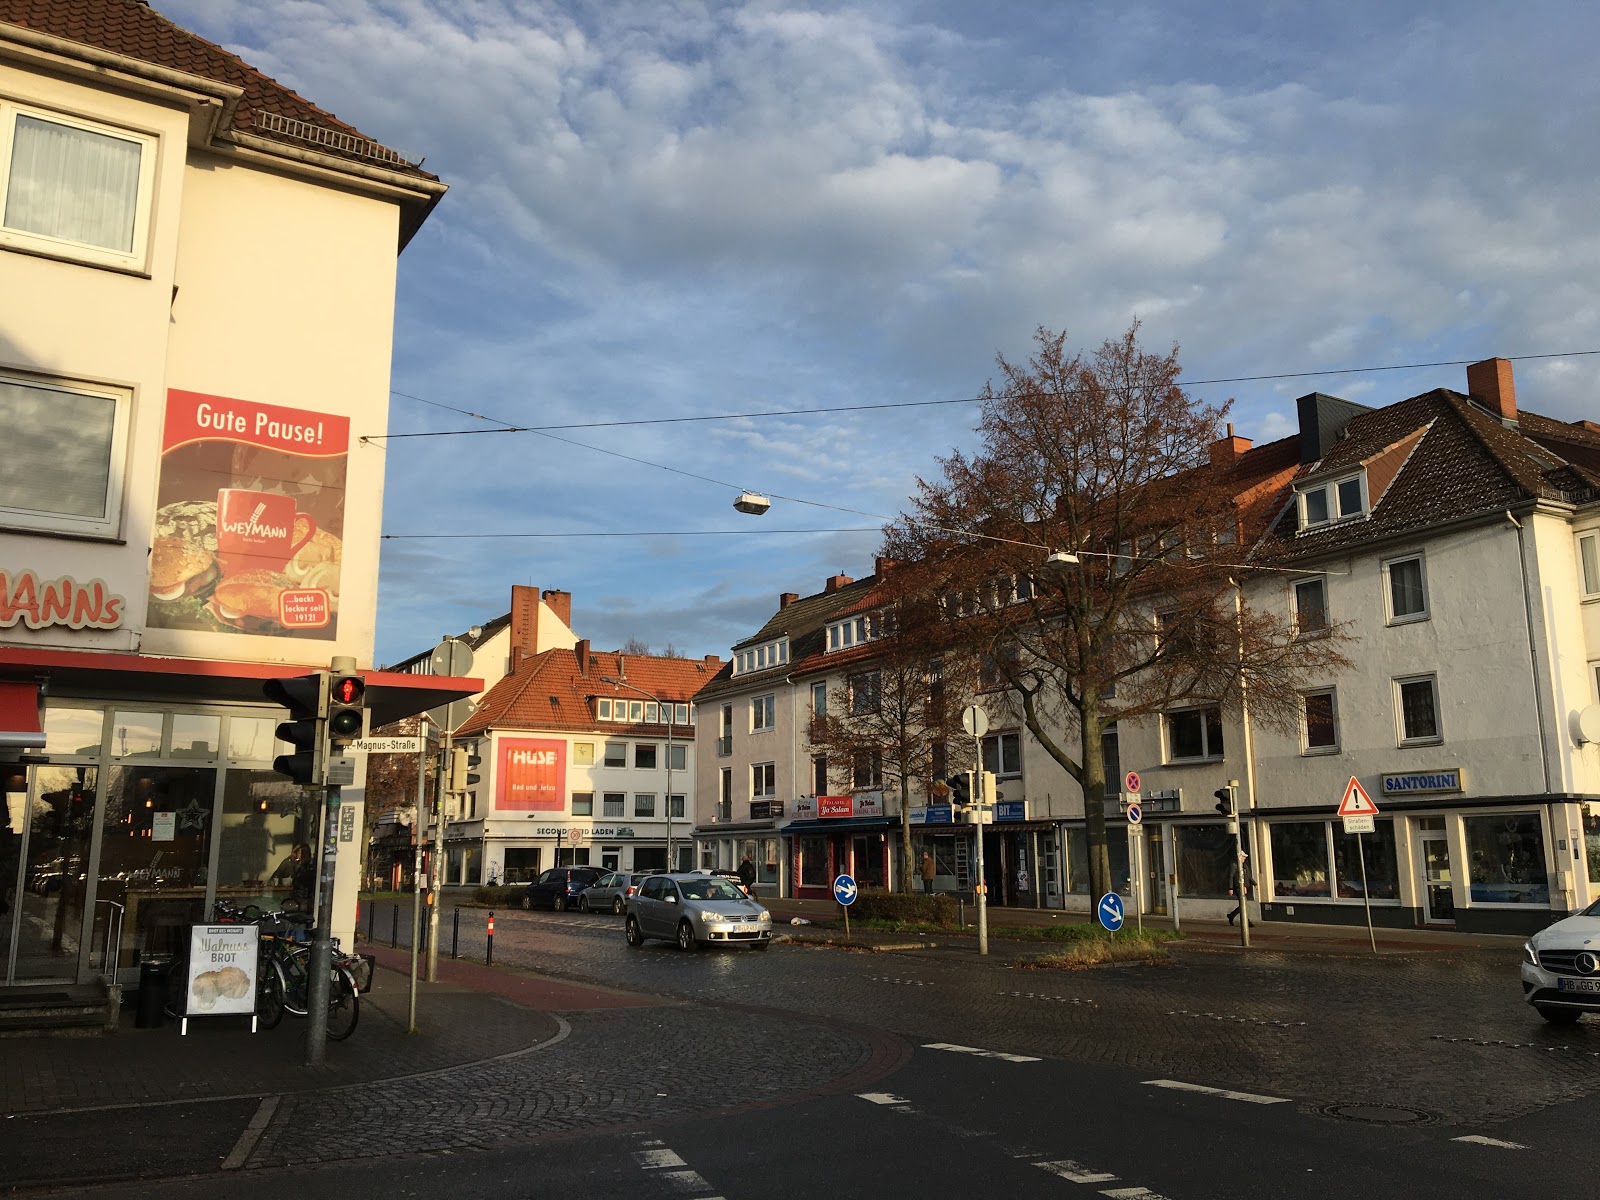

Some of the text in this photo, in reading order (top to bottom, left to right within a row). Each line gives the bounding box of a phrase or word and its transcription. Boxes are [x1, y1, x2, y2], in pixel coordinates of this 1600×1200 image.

[197, 403, 323, 444] Gute Pause!
[222, 522, 287, 538] WEYMANN
[285, 604, 324, 613] lecker seit
[294, 613, 316, 621] 1912!
[1386, 774, 1456, 790] SANTORINI
[821, 806, 831, 815] Ya
[831, 805, 850, 814] Salam
[998, 804, 1011, 816] BIT
[199, 938, 251, 952] Walnuss
[211, 953, 236, 962] BROT
[1563, 980, 1575, 990] HB
[1580, 981, 1594, 991] GG
